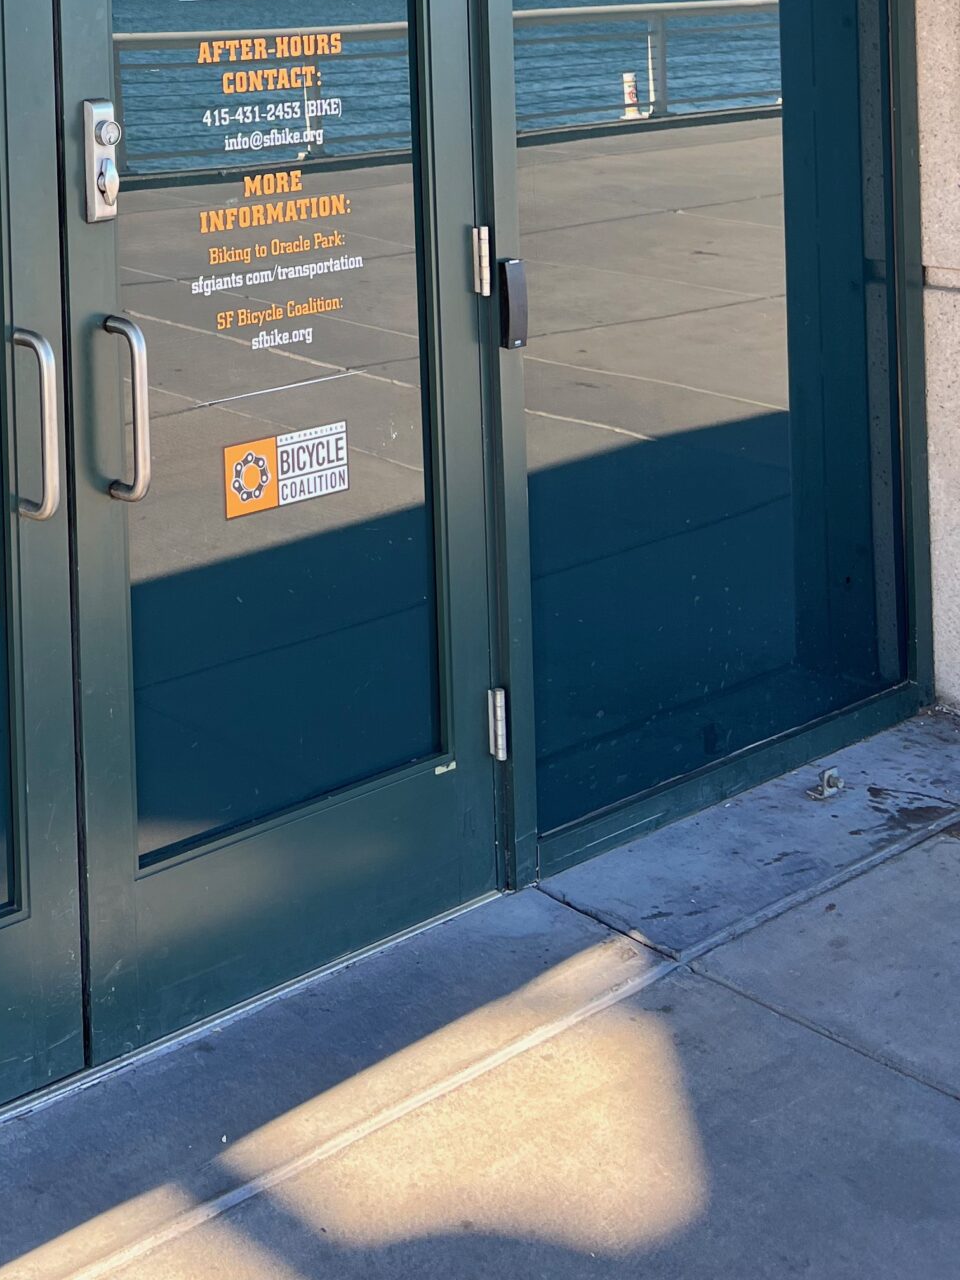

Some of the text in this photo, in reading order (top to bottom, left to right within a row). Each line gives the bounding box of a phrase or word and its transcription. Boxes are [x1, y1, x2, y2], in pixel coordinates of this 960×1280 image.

[197, 33, 342, 64] AFTER-HOURS
[222, 66, 322, 94] CONTACT:
[202, 98, 342, 127] 415-431-2453 (BIKE)
[224, 128, 324, 151] info@sfbike.org
[244, 170, 303, 197] MORE
[200, 194, 351, 234] INFORMATION:
[209, 230, 346, 265] Biking to Oracle Park:
[216, 297, 343, 330] SF Bicycle Coalition:
[251, 327, 313, 350] sfbike.org
[280, 436, 345, 476] BICYCLE
[281, 469, 346, 501] COALITION
